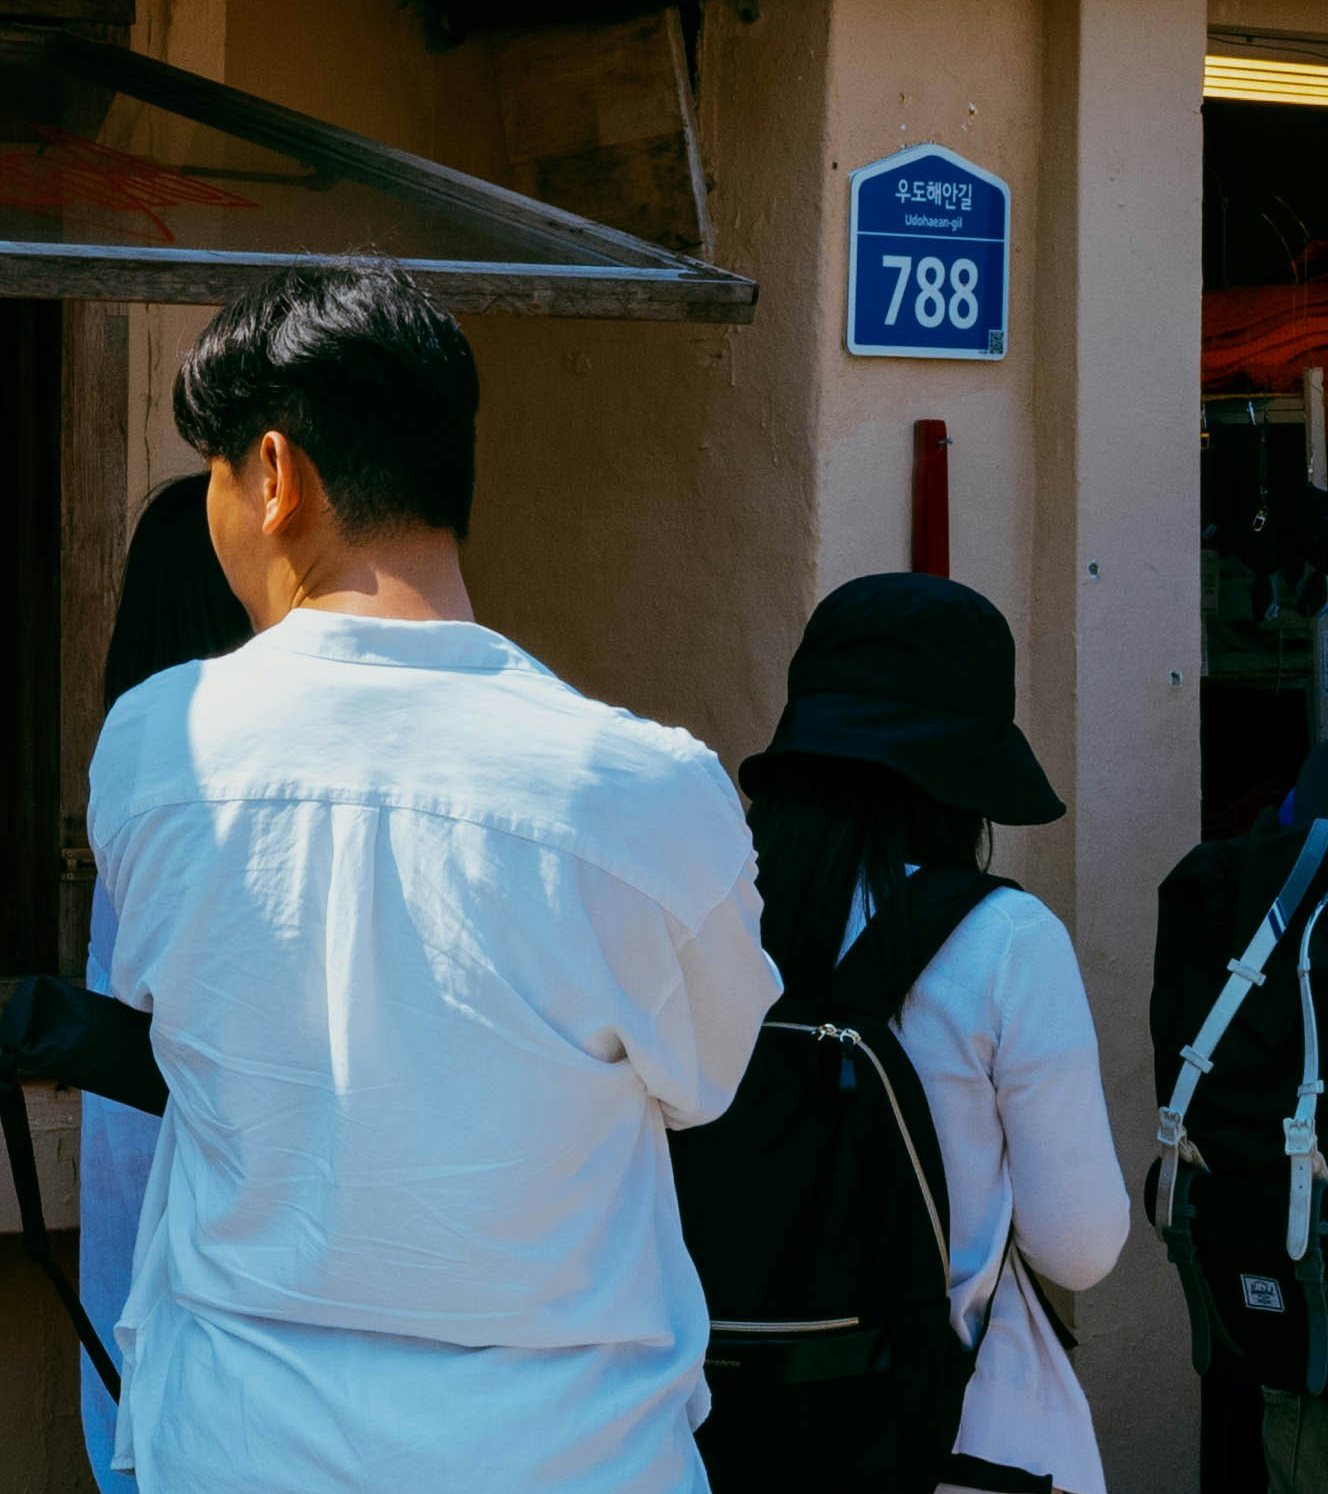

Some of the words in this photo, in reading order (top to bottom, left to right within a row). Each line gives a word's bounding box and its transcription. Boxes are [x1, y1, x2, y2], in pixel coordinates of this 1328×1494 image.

[895, 179, 973, 211] 우도해안길
[904, 214, 963, 232] Udohaean-gil
[882, 254, 979, 330] 788
